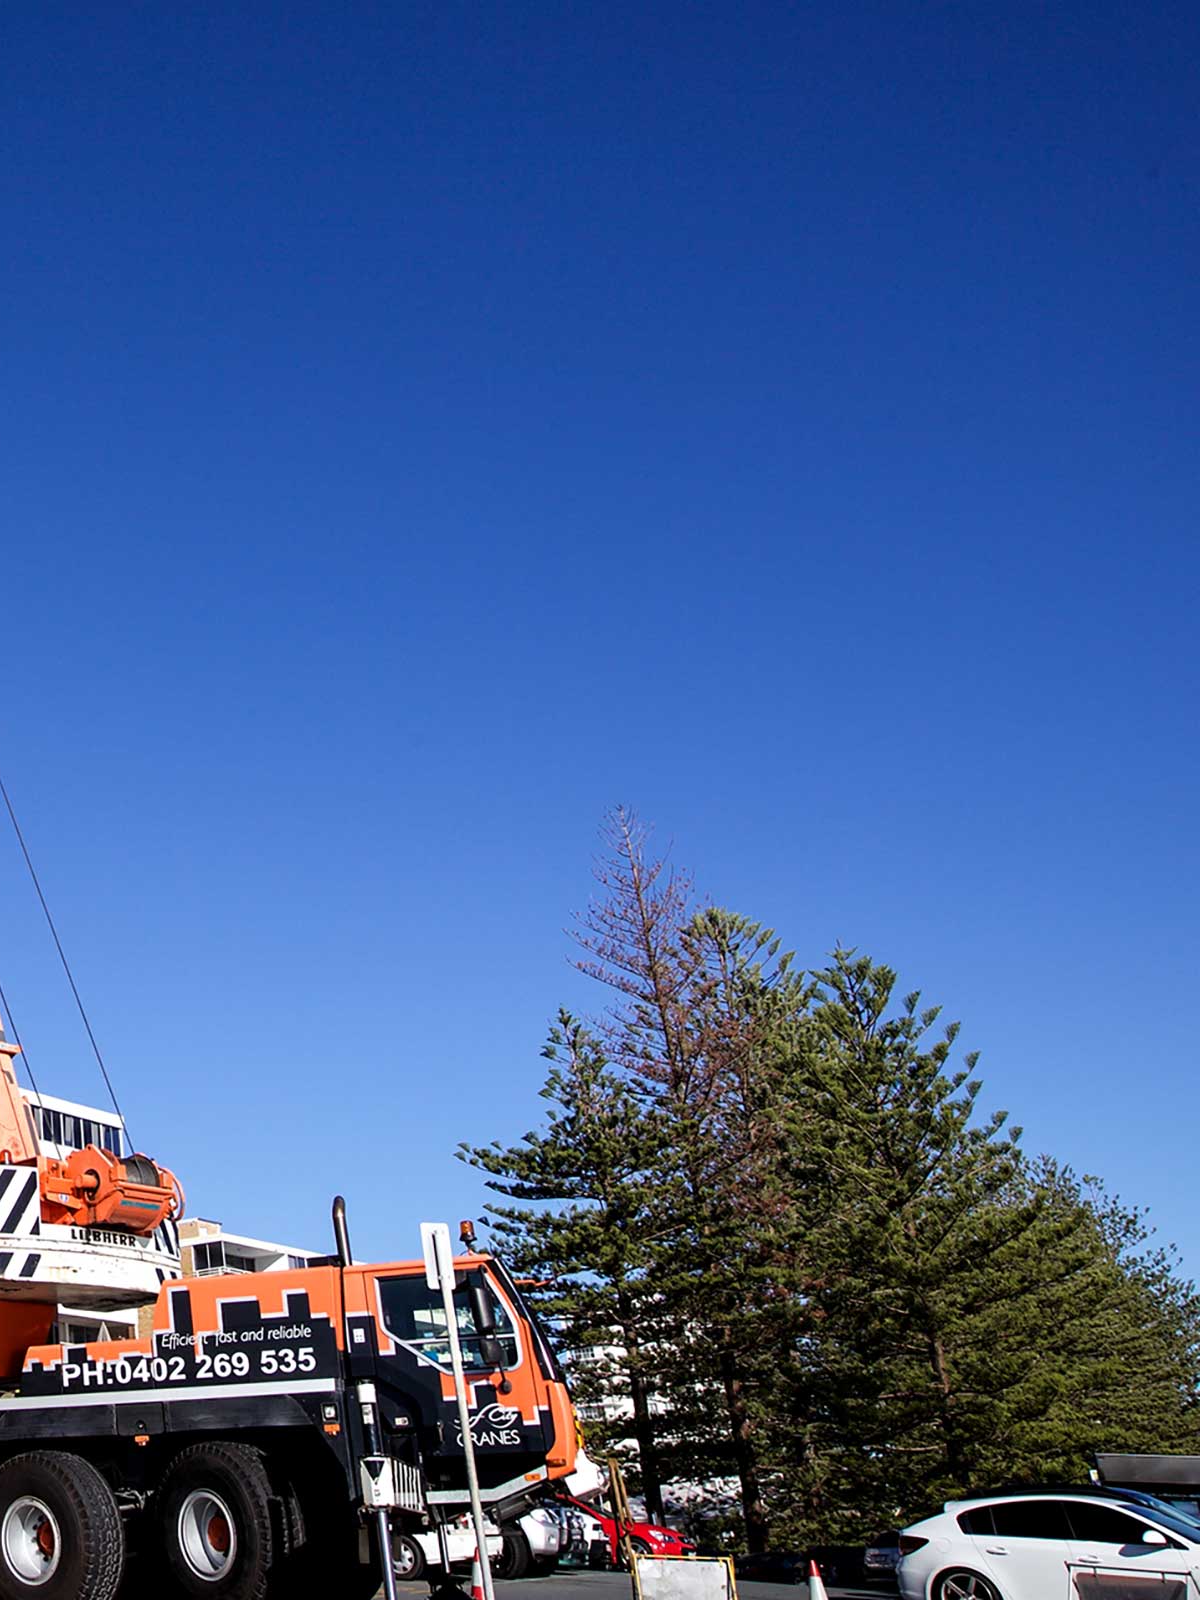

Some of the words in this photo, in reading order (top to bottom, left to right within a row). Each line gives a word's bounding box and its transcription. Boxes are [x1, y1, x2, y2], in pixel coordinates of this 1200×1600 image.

[240, 1327, 264, 1342] and
[267, 1324, 311, 1340] reliable
[196, 1352, 249, 1379] 269
[260, 1347, 317, 1373] 535
